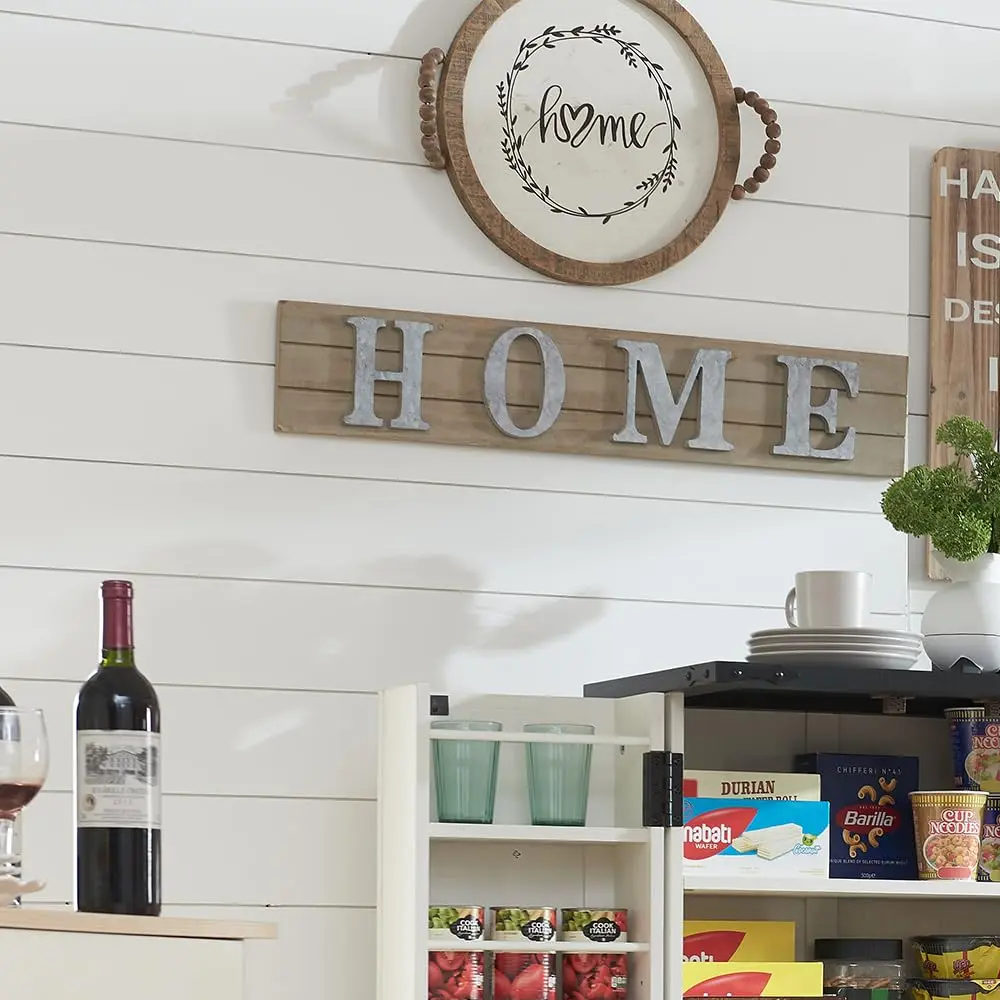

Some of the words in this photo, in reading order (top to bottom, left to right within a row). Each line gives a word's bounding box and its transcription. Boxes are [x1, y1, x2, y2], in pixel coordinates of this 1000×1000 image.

[343, 316, 860, 461] HOME
[721, 780, 775, 796] DURIAN
[844, 811, 894, 827] Barilla
[941, 811, 973, 823] CUP
[682, 823, 732, 843] nabati
[929, 822, 980, 835] NOODLES
